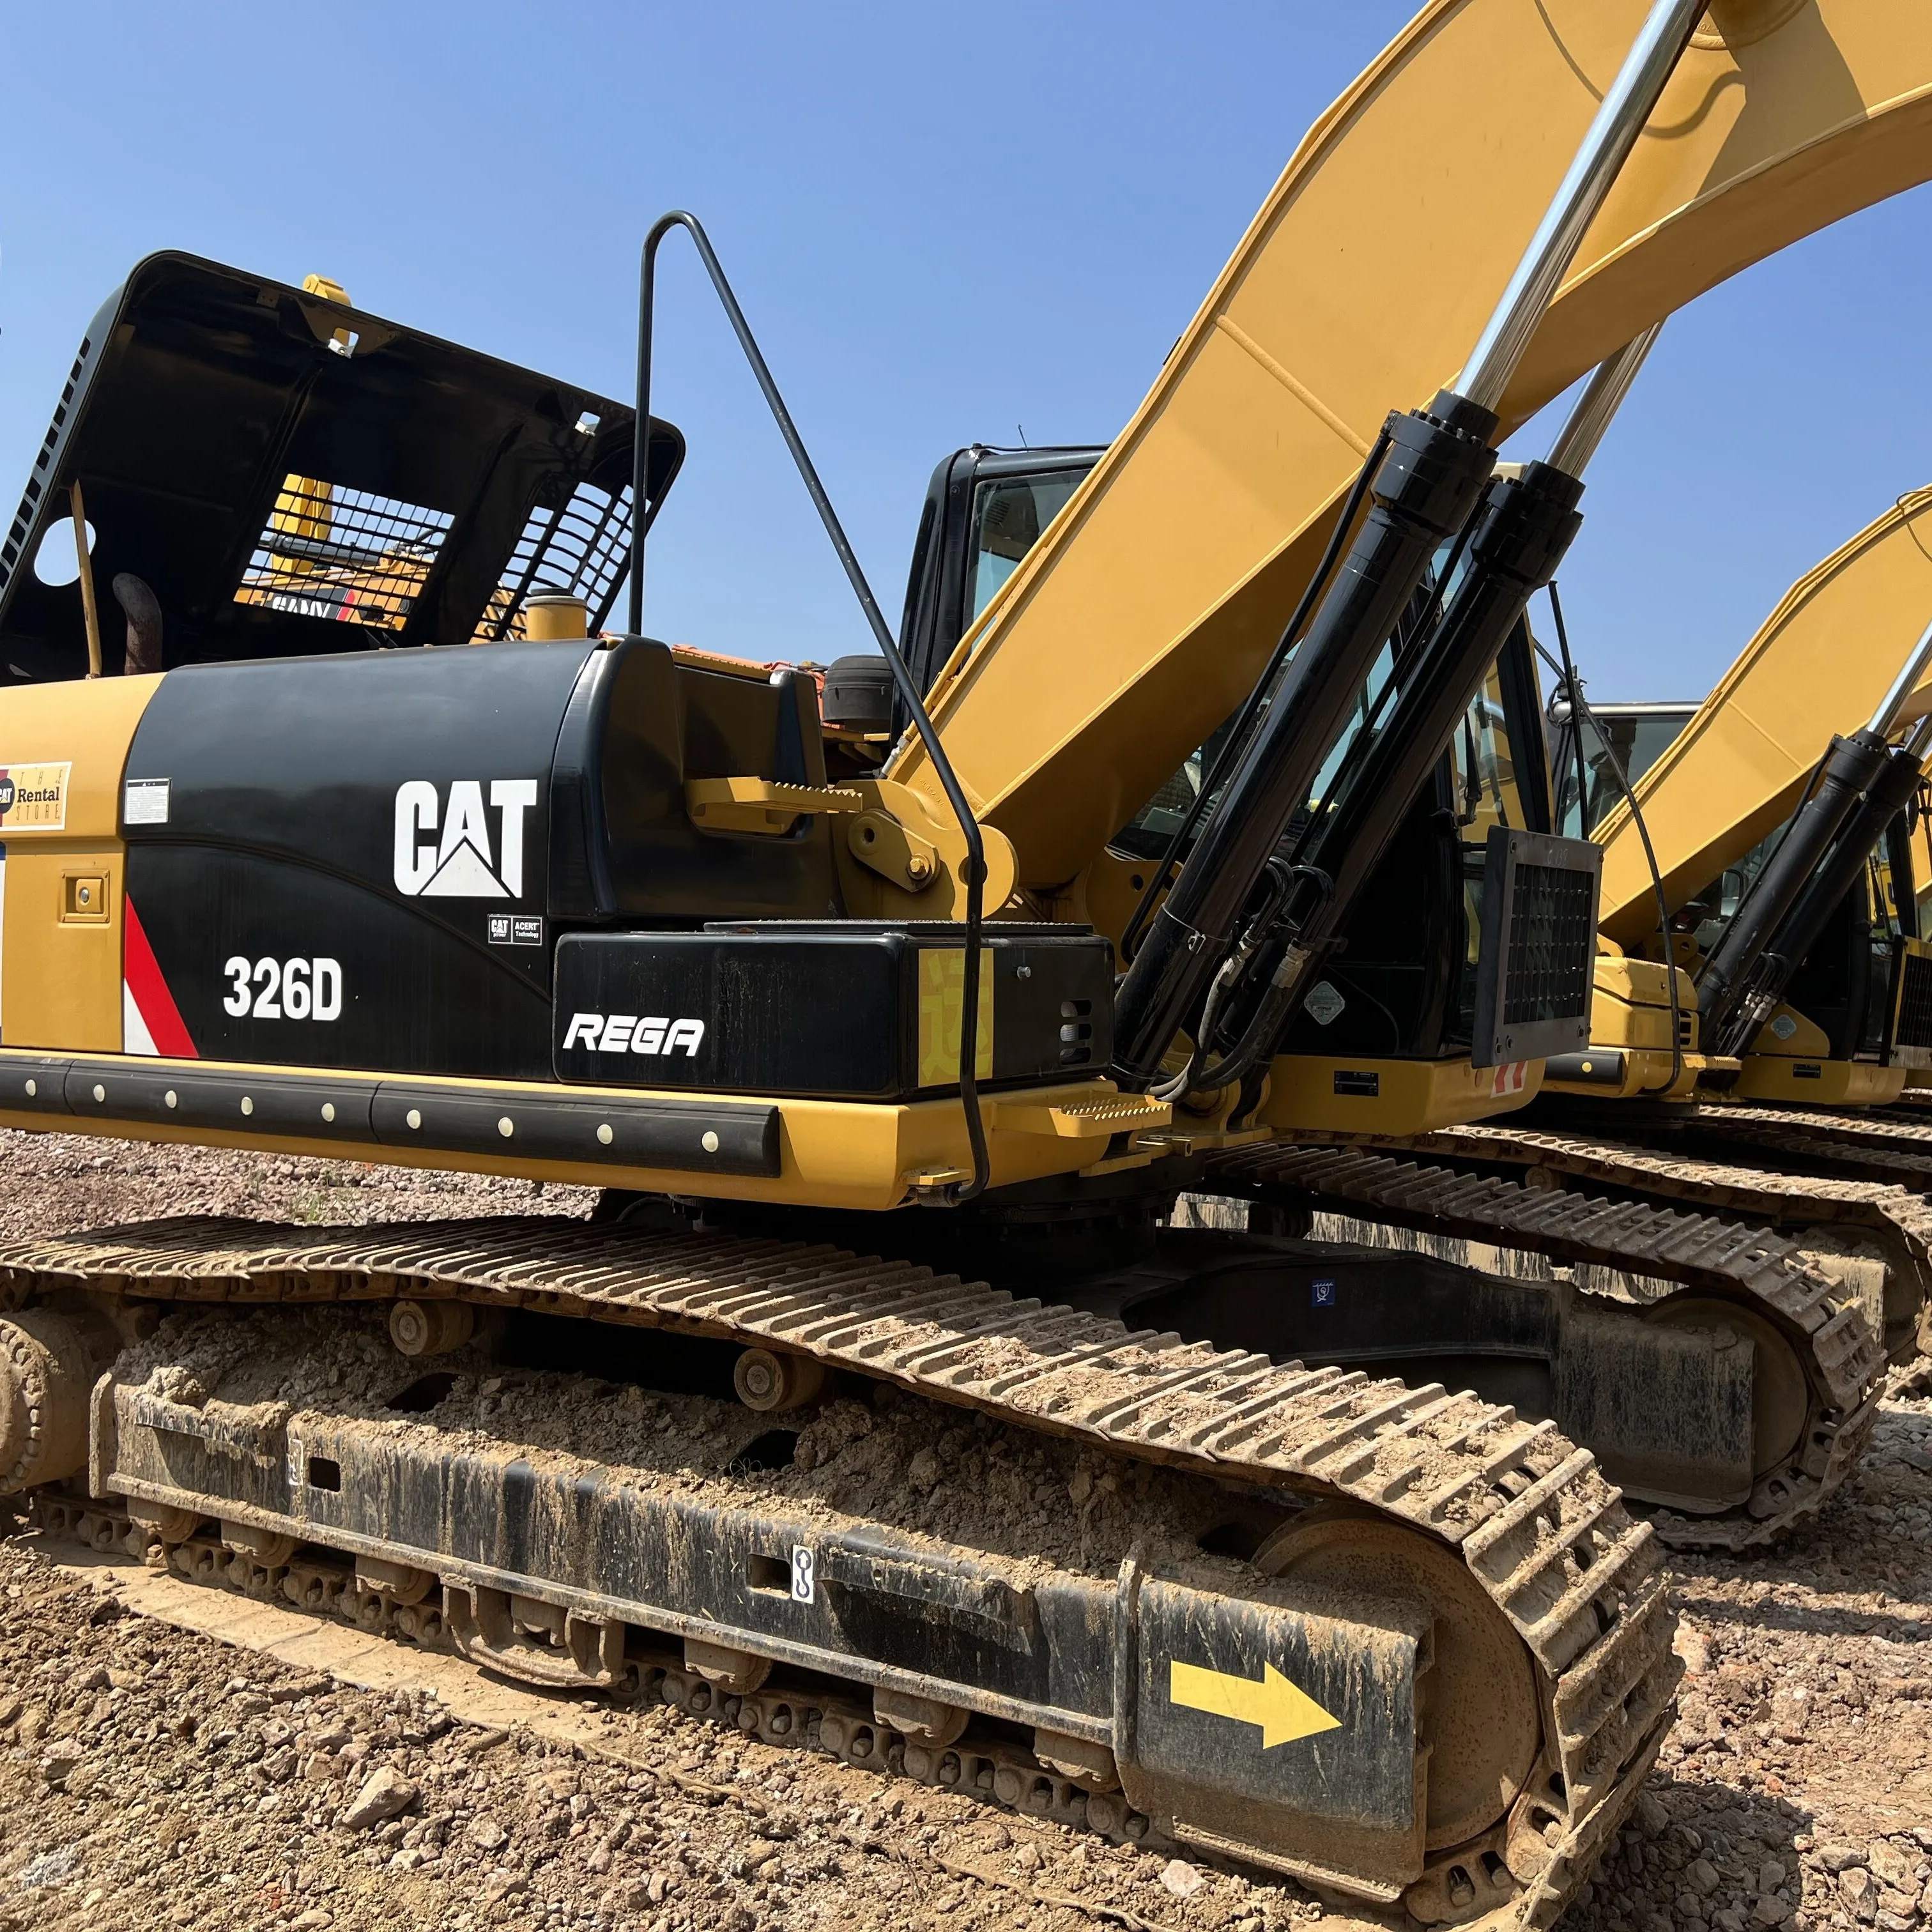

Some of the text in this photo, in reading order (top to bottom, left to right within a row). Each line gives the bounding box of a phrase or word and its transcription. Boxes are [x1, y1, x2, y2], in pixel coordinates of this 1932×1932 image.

[17, 786, 60, 803] Rental
[394, 779, 537, 898] CAT
[491, 919, 509, 933] CAT
[223, 956, 342, 1022] 326D
[562, 1013, 705, 1057] REGA
